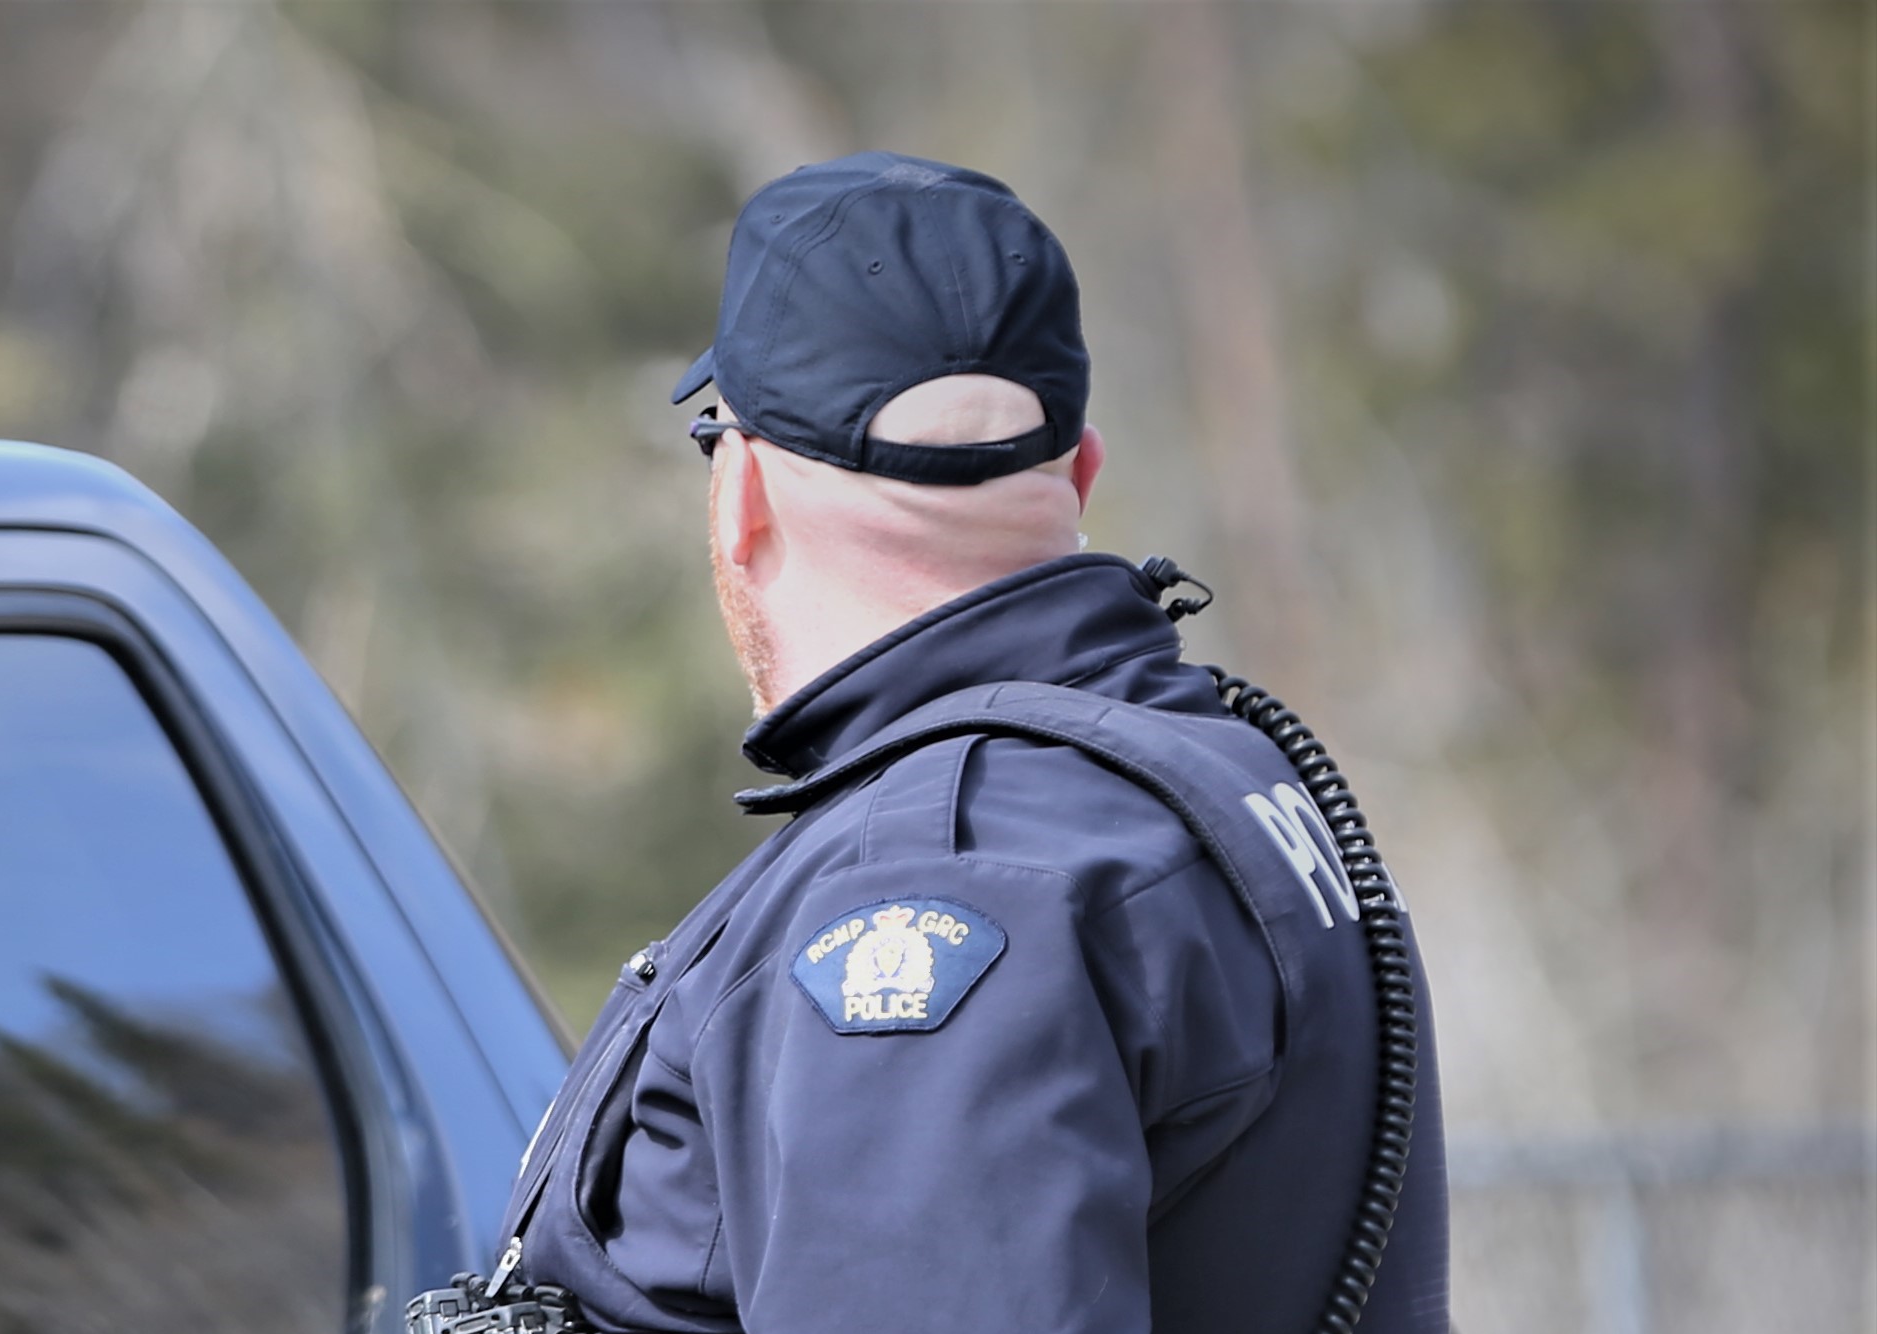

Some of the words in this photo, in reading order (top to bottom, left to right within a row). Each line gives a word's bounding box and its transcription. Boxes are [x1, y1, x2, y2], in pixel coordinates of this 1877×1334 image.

[807, 918, 865, 964] RCMP
[918, 911, 969, 945] GRC
[844, 993, 929, 1021] POLICE
